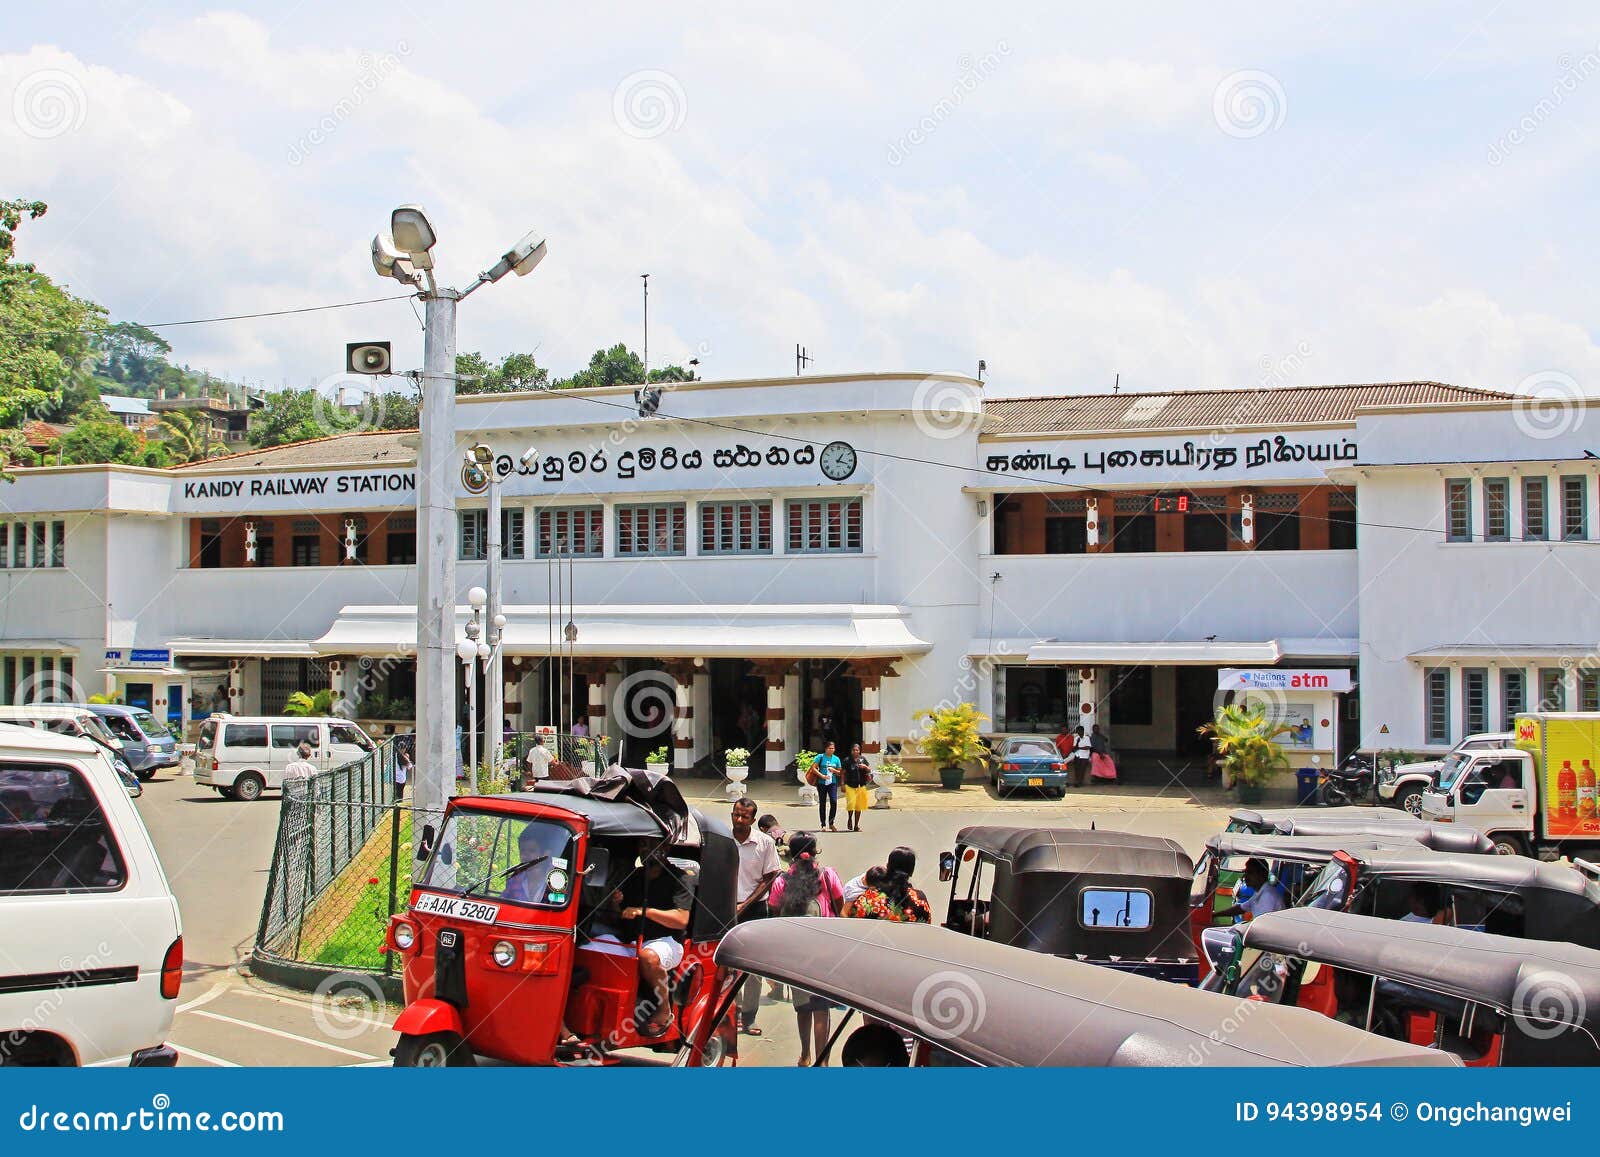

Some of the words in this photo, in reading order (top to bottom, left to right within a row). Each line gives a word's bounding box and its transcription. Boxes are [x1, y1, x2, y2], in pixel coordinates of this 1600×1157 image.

[986, 449, 1076, 476] கண்டி
[1084, 441, 1238, 474] புகையிரத
[1245, 435, 1358, 469] நிலையம்
[185, 481, 244, 498] KANDY
[251, 477, 328, 496] RAILWAY
[337, 473, 416, 493] STATION
[105, 651, 121, 659] ATM
[1253, 672, 1286, 681] Nations
[1291, 672, 1329, 688] atm
[1583, 823, 1600, 831] SM
[429, 897, 459, 915] AAK
[459, 902, 496, 921] 5280
